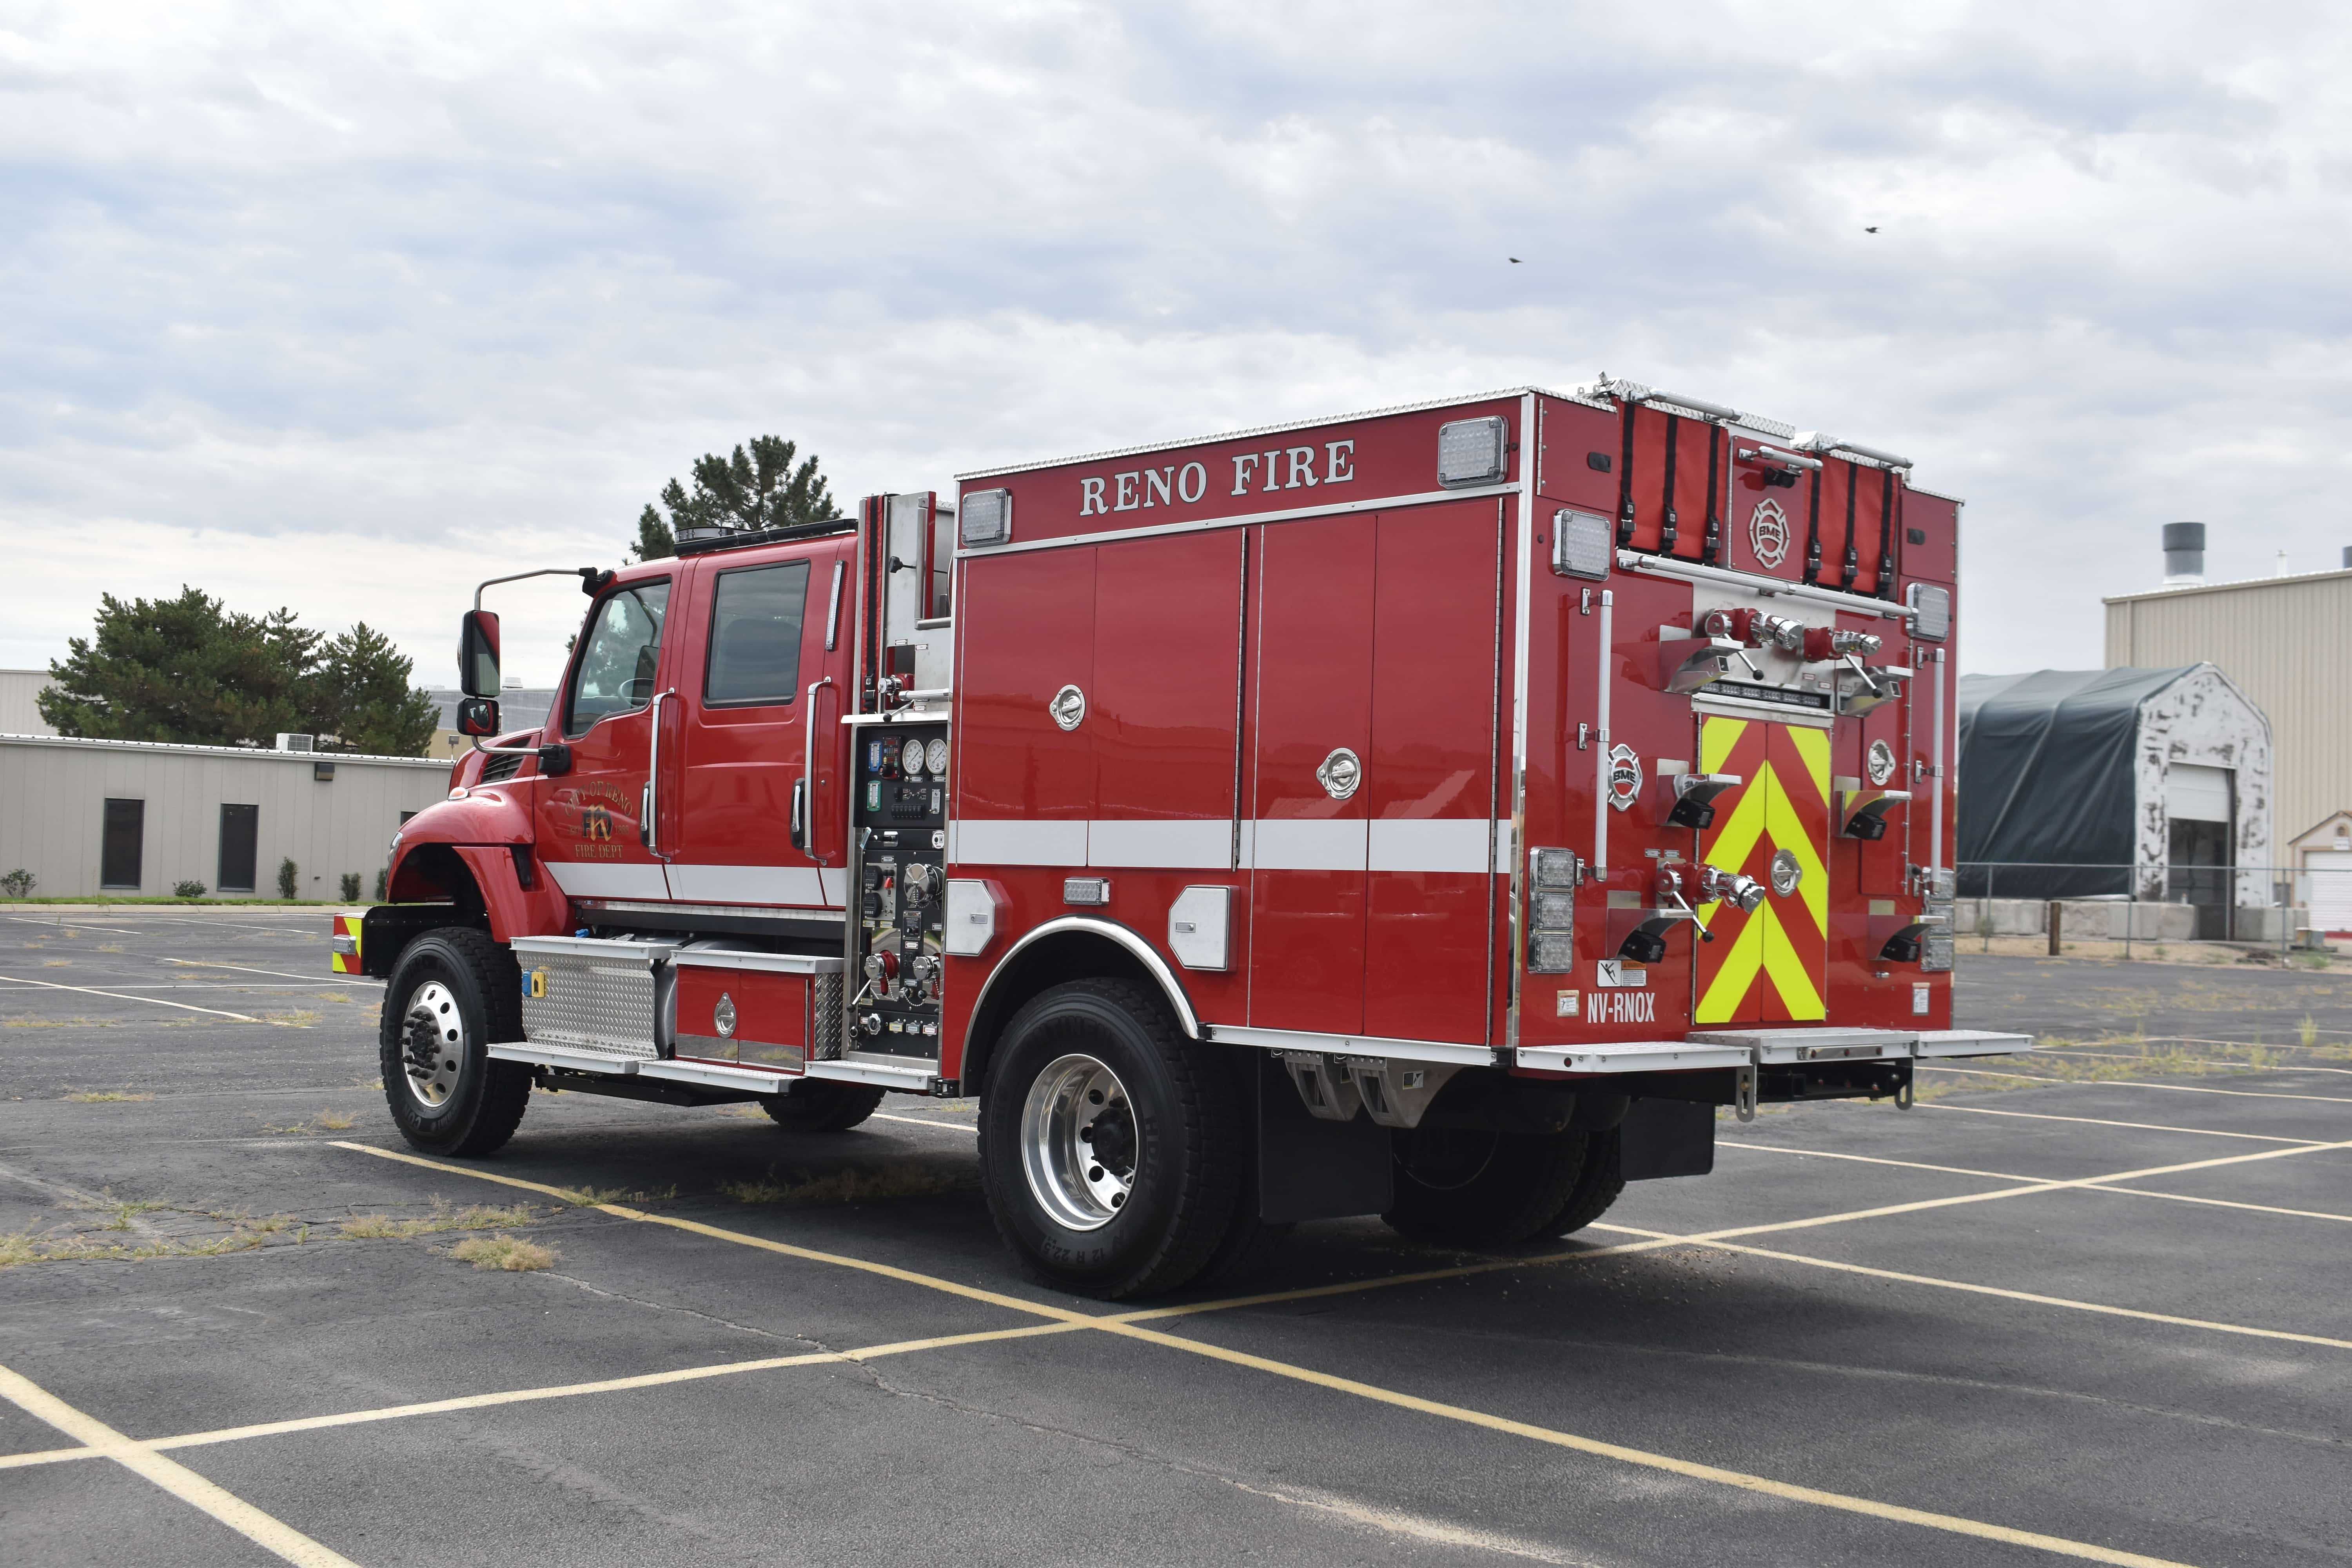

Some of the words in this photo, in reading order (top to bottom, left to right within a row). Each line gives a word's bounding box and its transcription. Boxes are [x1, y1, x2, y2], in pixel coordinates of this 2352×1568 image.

[1080, 462, 1207, 516] RENO
[1230, 439, 1354, 496] FIRE
[1759, 525, 1781, 541] BME
[1613, 769, 1636, 784] BME
[565, 784, 586, 817] CITY
[589, 781, 603, 796] OF
[605, 782, 633, 817] RENO
[575, 844, 596, 858] FIRE
[599, 844, 623, 858] DEPT
[1588, 992, 1655, 1024] NV-RNOX
[1044, 1242, 1071, 1262] 22.5
[1076, 1251, 1085, 1264] R
[1092, 1248, 1105, 1263] 12
